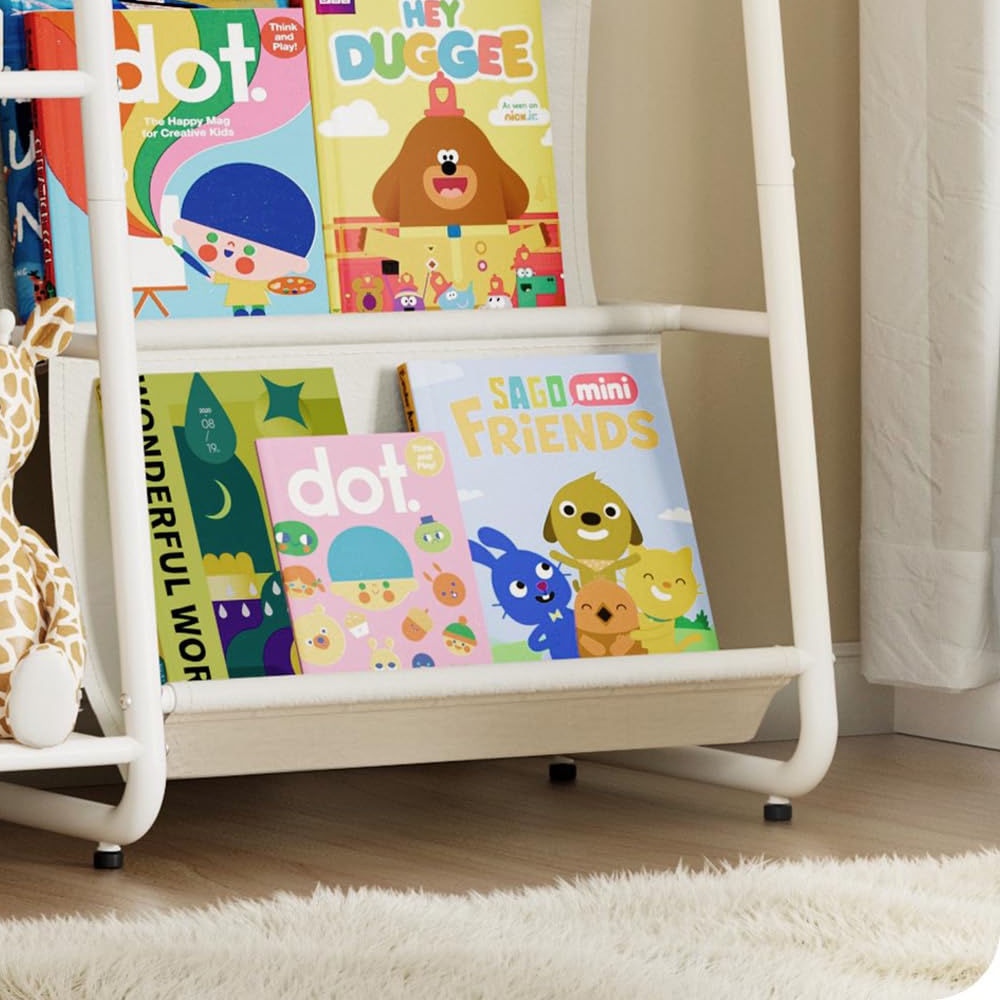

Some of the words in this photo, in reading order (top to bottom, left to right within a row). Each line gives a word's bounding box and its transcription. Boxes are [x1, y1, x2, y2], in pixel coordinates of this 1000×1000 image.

[402, 0, 461, 28] HEY
[268, 22, 298, 32] Think
[274, 32, 294, 41] and
[272, 42, 298, 53] Play!
[333, 29, 535, 82] DUGGEE
[144, 117, 164, 126] The
[167, 116, 204, 128] Happy
[206, 116, 231, 127] Mag
[141, 128, 158, 138] for
[160, 127, 206, 138] Creative
[209, 127, 235, 138] Kids
[488, 375, 568, 410] SAGO
[574, 377, 632, 402] mini
[201, 418, 216, 429] 08
[287, 443, 421, 517] dot.
